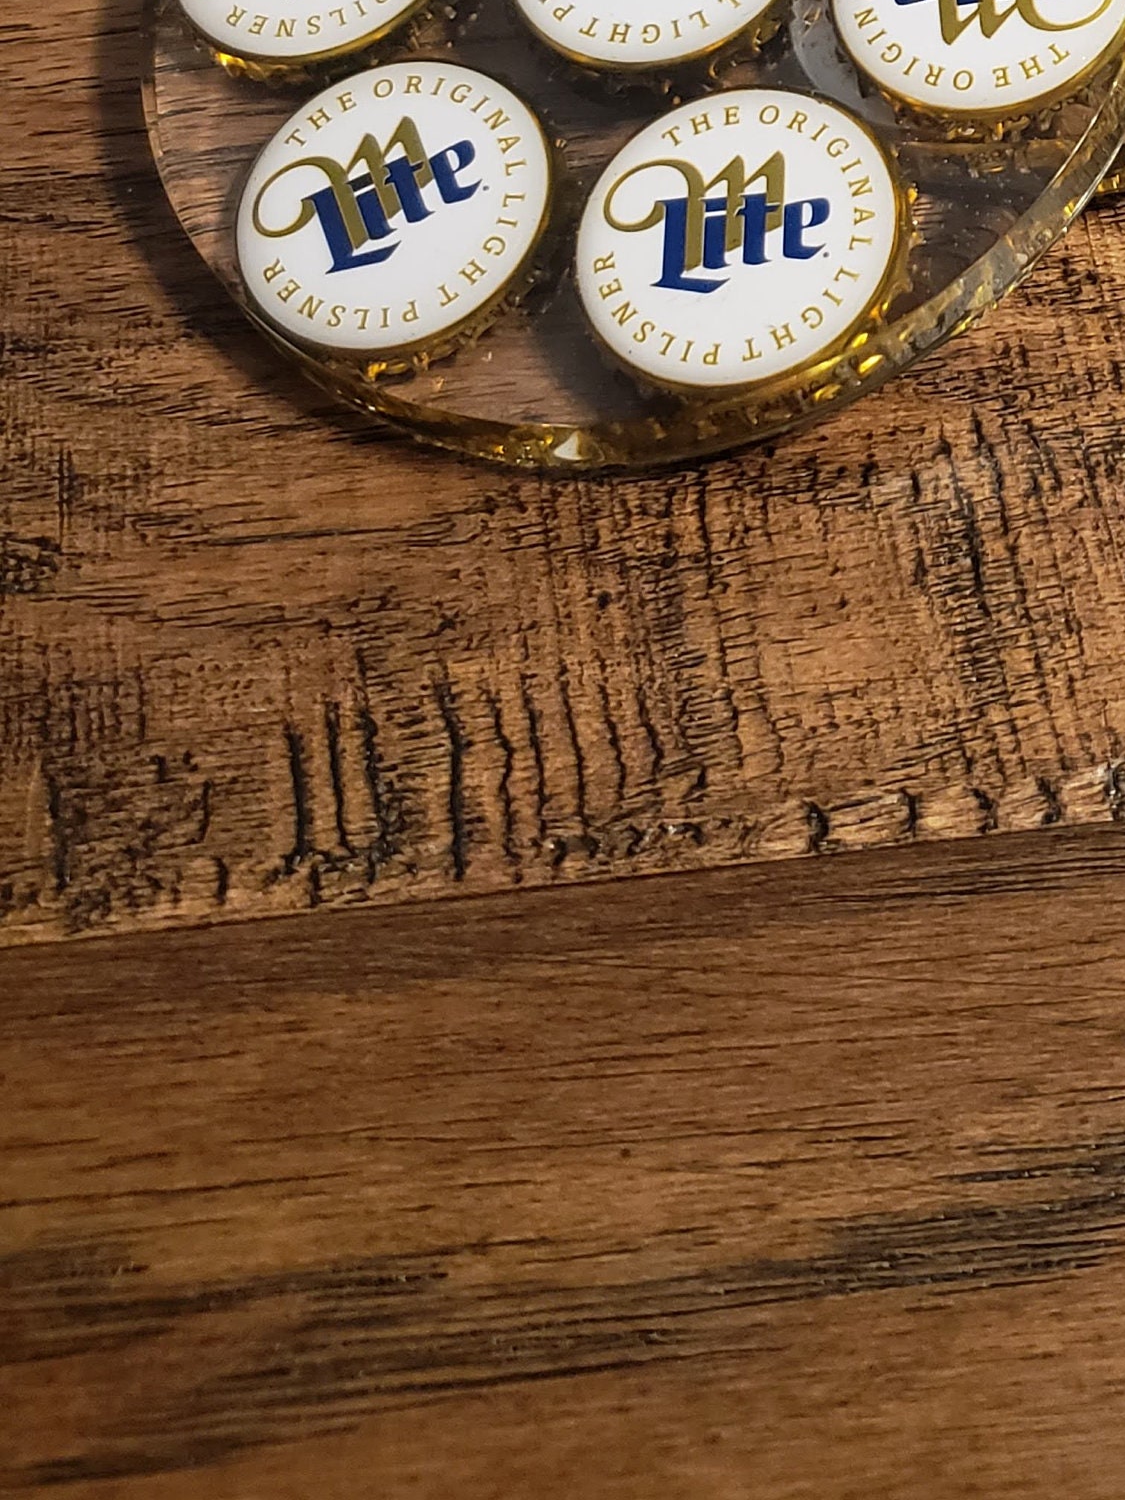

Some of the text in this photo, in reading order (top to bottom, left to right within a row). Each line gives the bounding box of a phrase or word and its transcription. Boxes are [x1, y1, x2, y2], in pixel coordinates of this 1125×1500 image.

[579, 10, 710, 44] LIGHT
[993, 44, 1071, 88] THE
[263, 76, 527, 329] THE ORIGINAL LIGHT PILSNER
[300, 140, 482, 274] Lite
[594, 105, 876, 365] THE ORIGINAL LIGHT PILSNER
[650, 193, 830, 293] Lite
